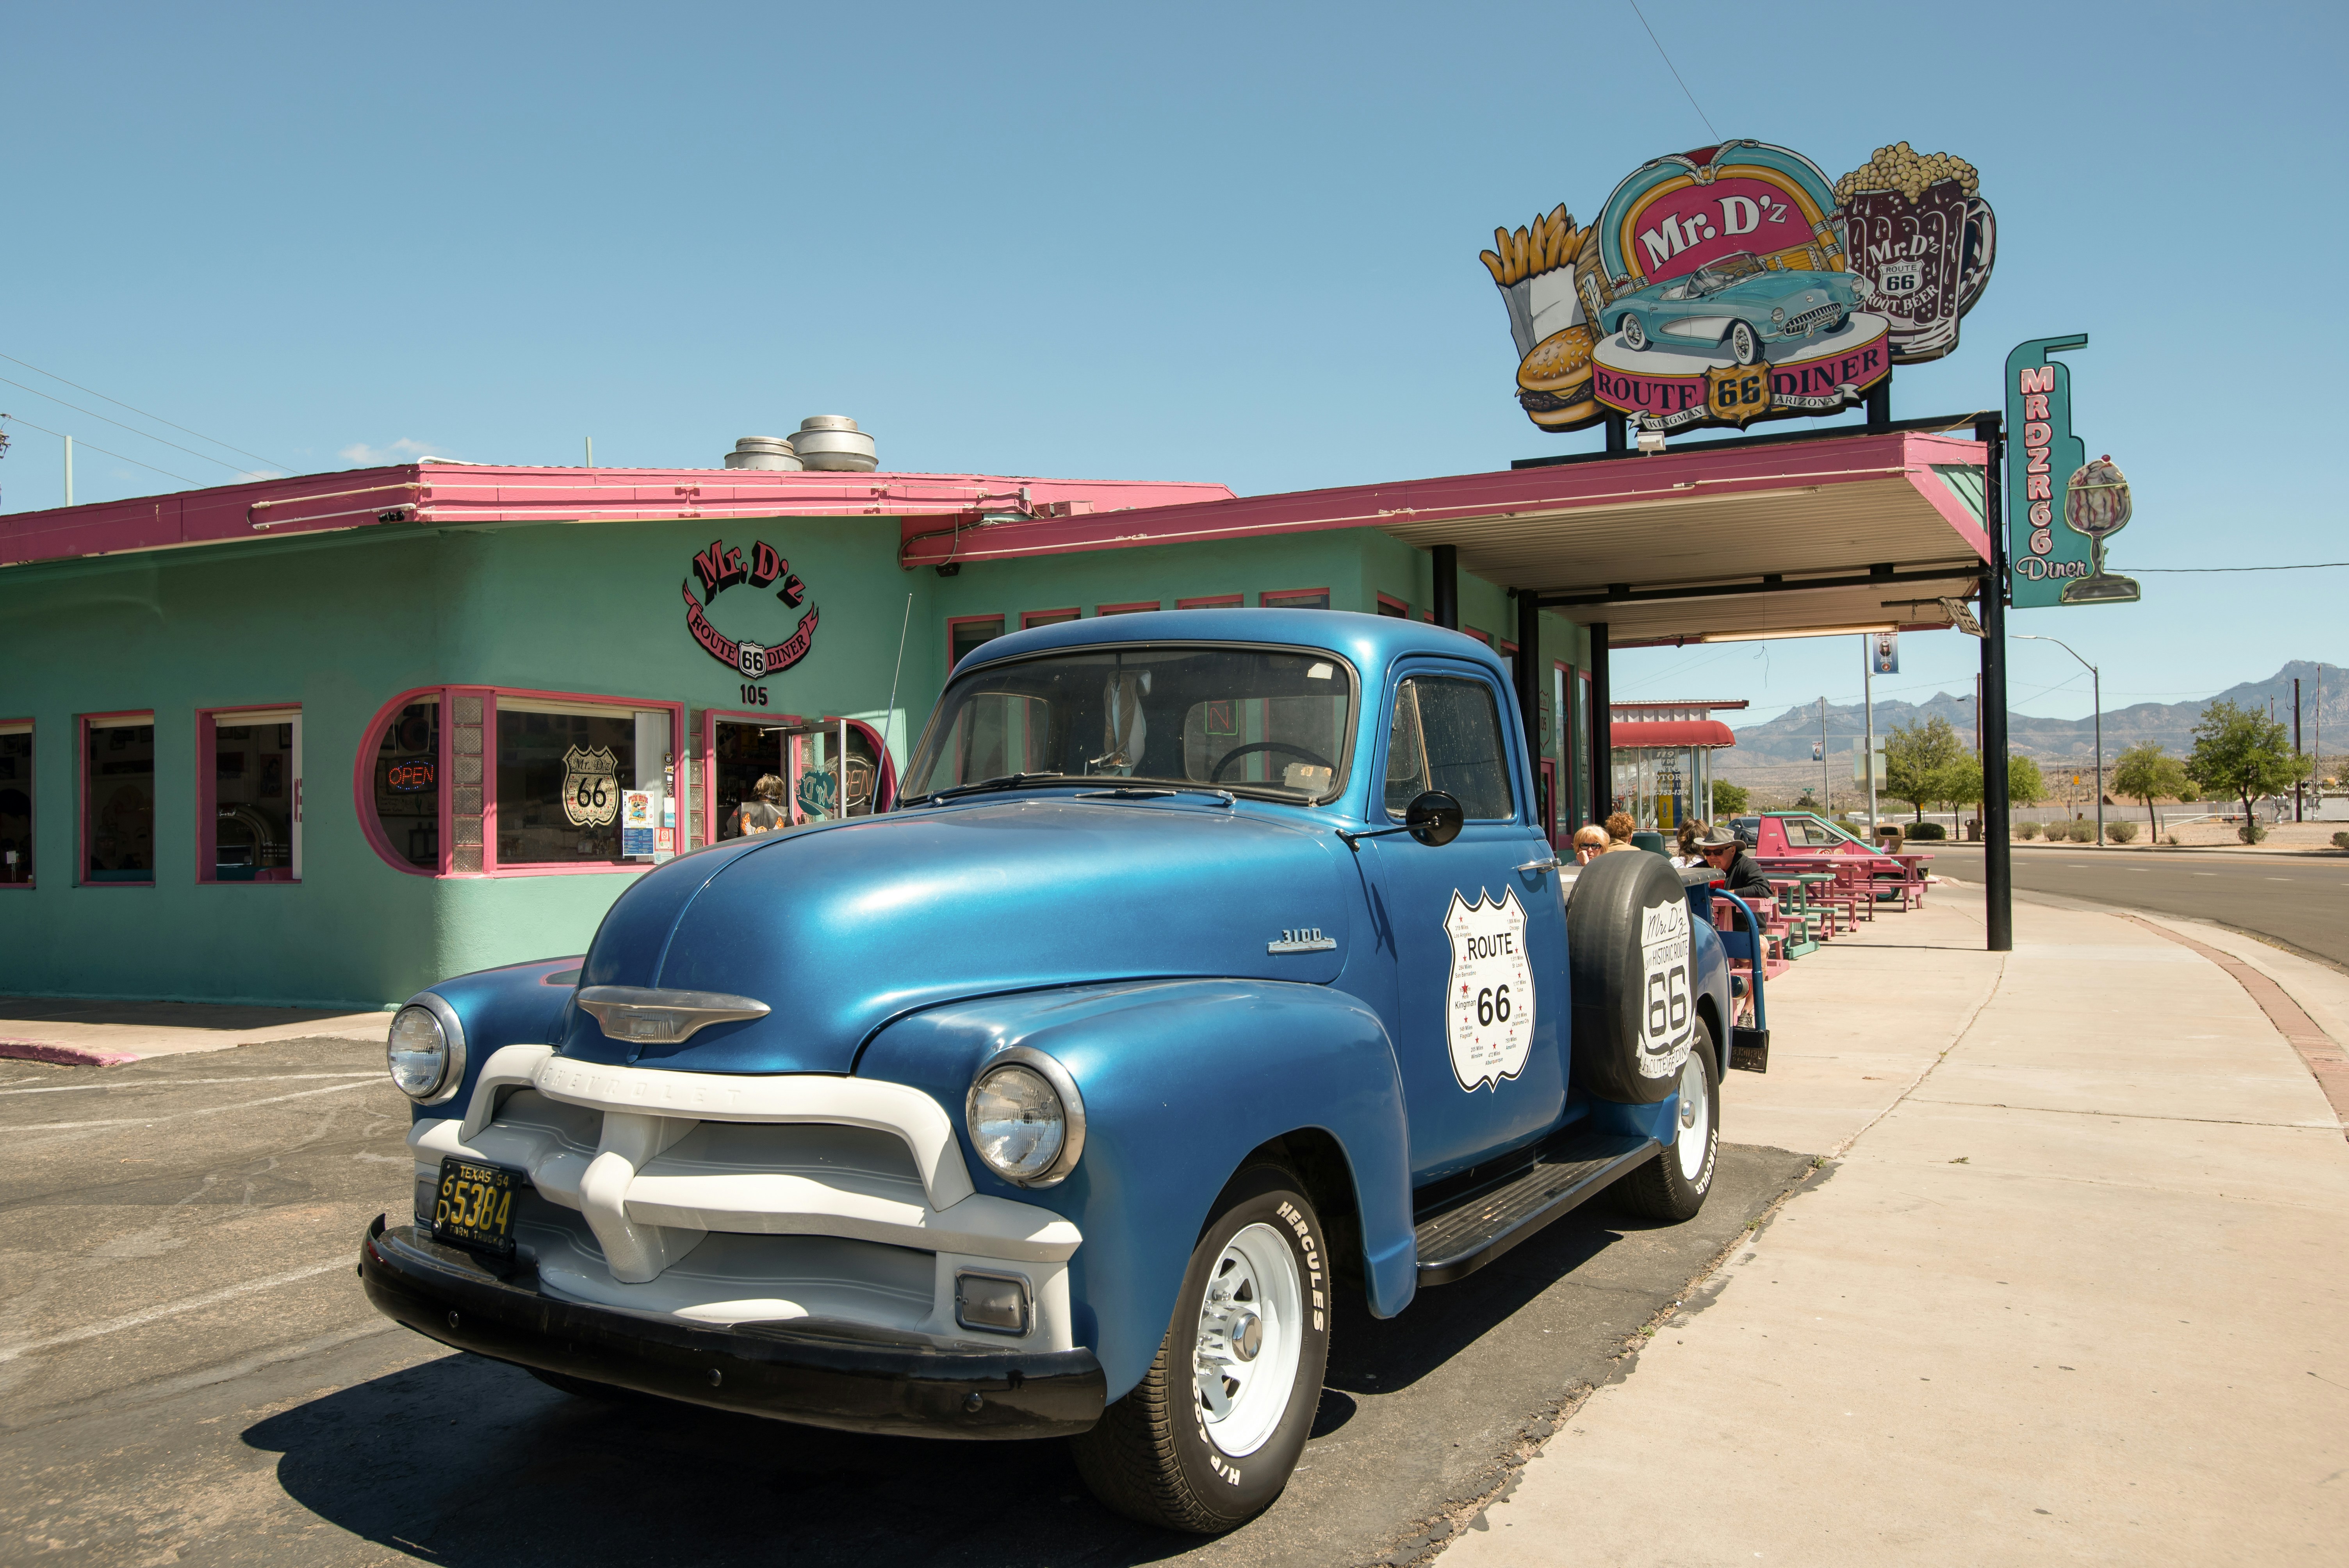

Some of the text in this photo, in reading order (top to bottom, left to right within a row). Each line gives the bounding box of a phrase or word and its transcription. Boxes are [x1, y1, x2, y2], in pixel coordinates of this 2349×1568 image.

[1638, 194, 1789, 274] Mr. D'z
[1867, 239, 1907, 265] Mr.
[1886, 264, 1917, 273] ROUTE
[1887, 274, 1914, 291] 66
[1865, 285, 1939, 312] ROOT BEER
[1597, 348, 1880, 410] ROUTE 66 DINER
[1649, 395, 1836, 428] KINGMAN ARIZONA
[693, 539, 806, 608] Mr. D'z
[2015, 555, 2087, 581] Diner
[691, 613, 807, 671] ROUTE 66 DINER
[741, 684, 768, 706] 105
[389, 766, 434, 784] OPEN
[573, 758, 590, 770] Mr.
[577, 778, 606, 808] 66
[1282, 928, 1321, 944] 3100
[1647, 913, 1666, 940] Mr.
[1467, 932, 1513, 960] ROUTE
[1652, 943, 1673, 966] HISTORIC
[1674, 939, 1688, 960] ROUTE
[1455, 1000, 1476, 1010] Kingman
[1477, 984, 1510, 1026] 66
[1649, 965, 1686, 1038] 66
[1485, 1057, 1503, 1066] Alburquerque
[1642, 1056, 1675, 1074] ROUTE 66
[460, 1165, 509, 1187] TEXAS 54
[451, 1181, 511, 1235] 5384
[449, 1225, 498, 1243] FARM TRUCK
[1277, 1201, 1324, 1332] HERCULES
[1211, 1455, 1240, 1487] H/P
